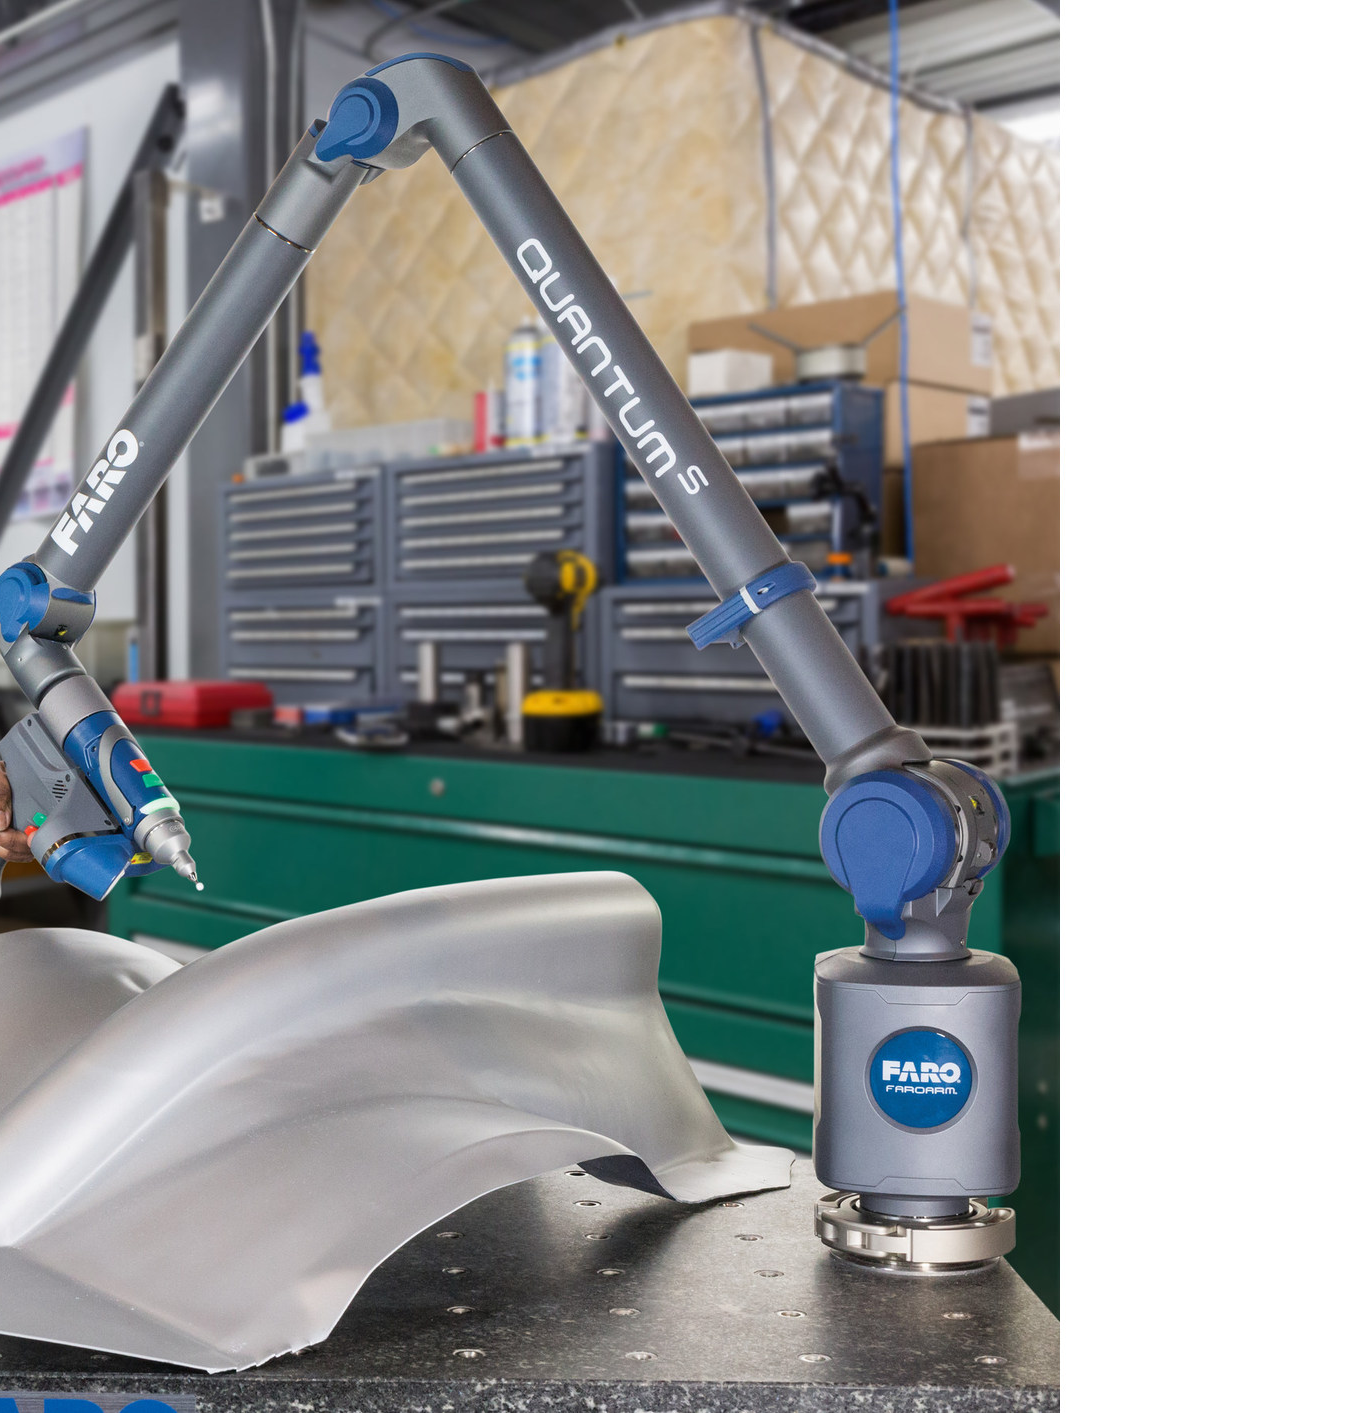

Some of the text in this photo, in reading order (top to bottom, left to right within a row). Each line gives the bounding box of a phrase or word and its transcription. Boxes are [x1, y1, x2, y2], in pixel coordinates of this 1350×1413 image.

[517, 238, 709, 495] QUANTUM S
[51, 429, 139, 556] FARO
[882, 1060, 961, 1083] FARO
